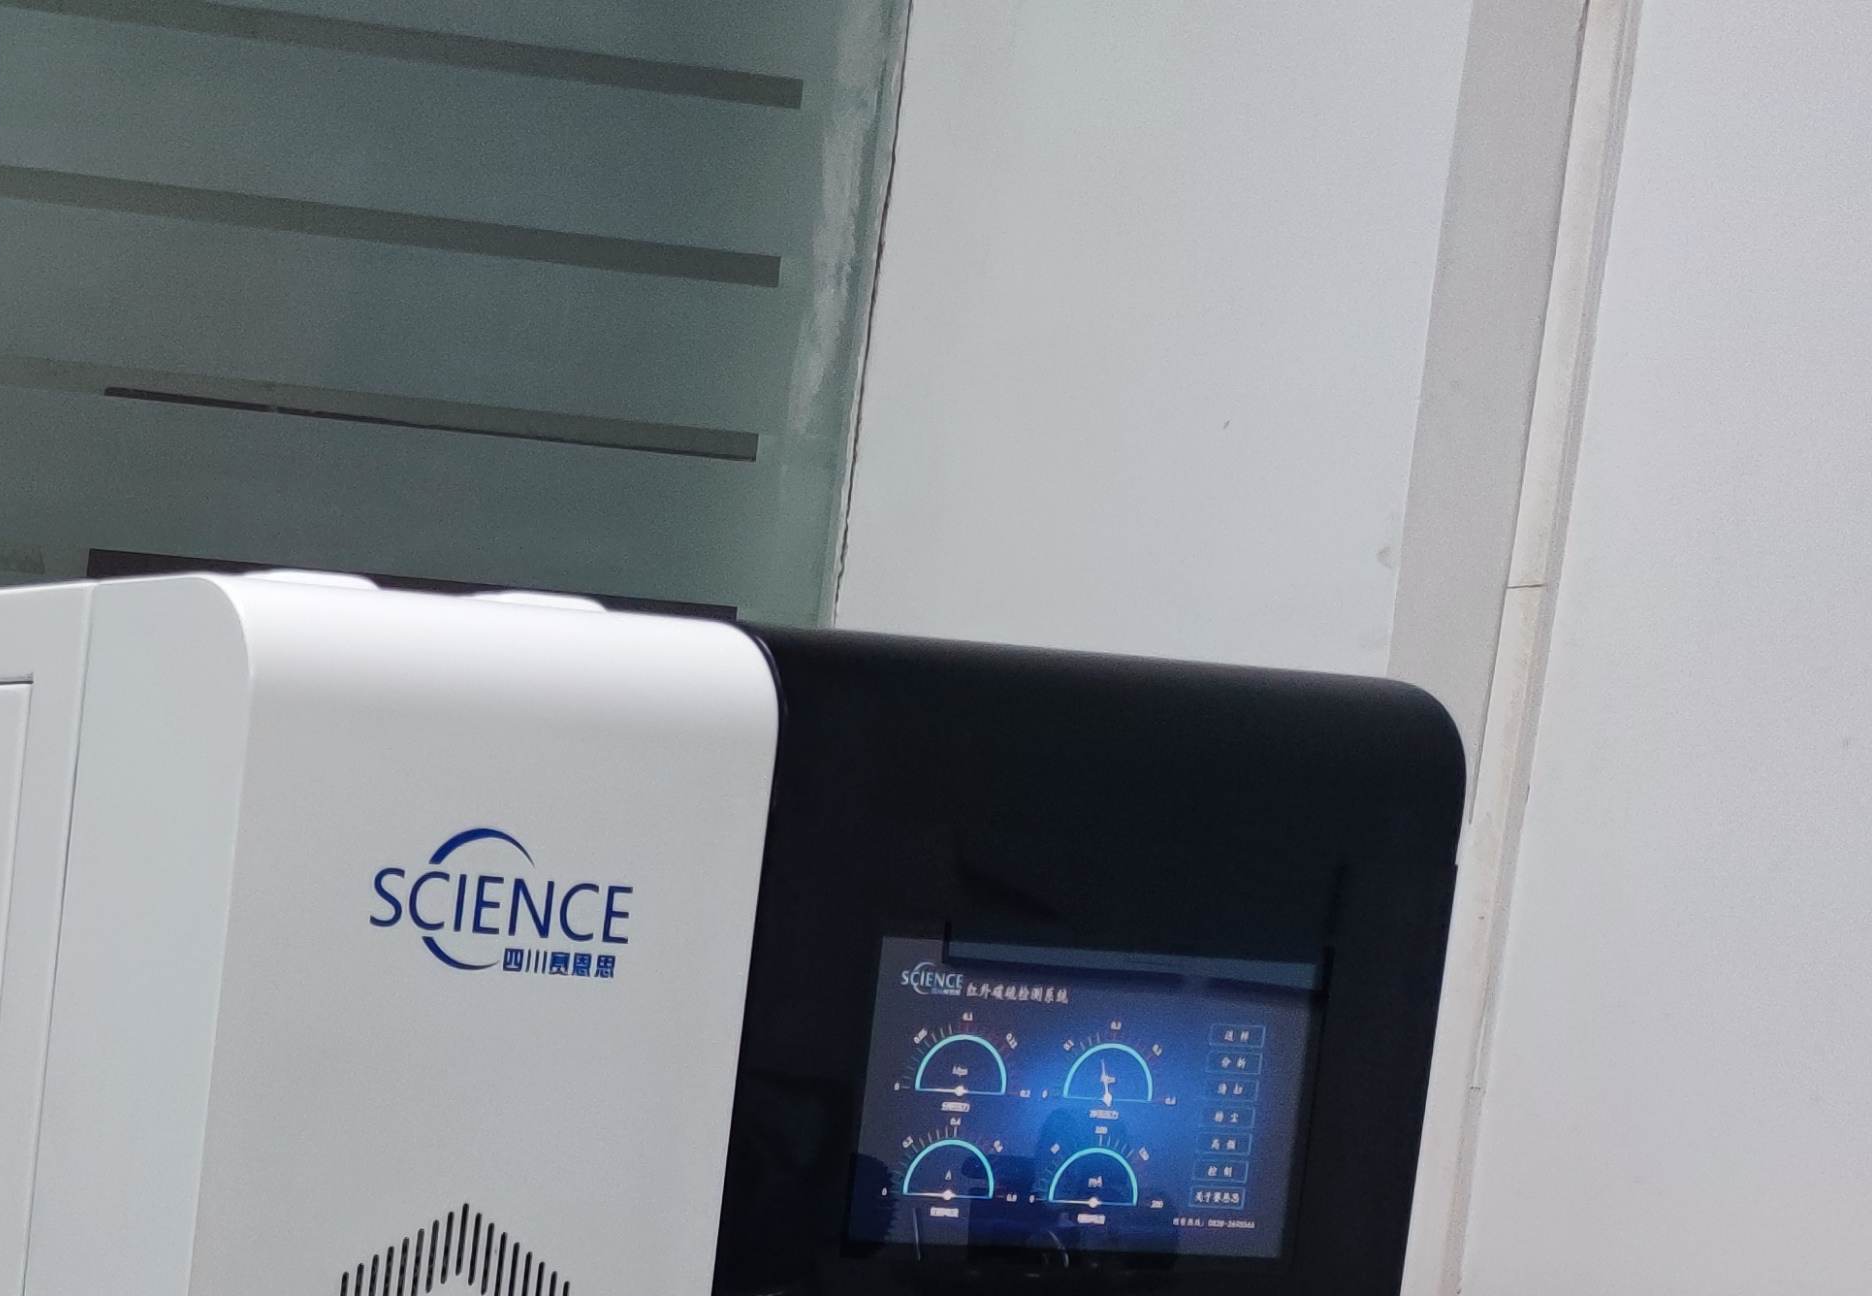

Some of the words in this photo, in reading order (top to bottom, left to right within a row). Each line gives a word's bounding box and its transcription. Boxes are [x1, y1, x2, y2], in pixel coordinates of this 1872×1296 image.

[370, 867, 633, 944] SCIENCE
[502, 947, 616, 979] 四川赛恩思
[901, 970, 963, 988] SCIENCE
